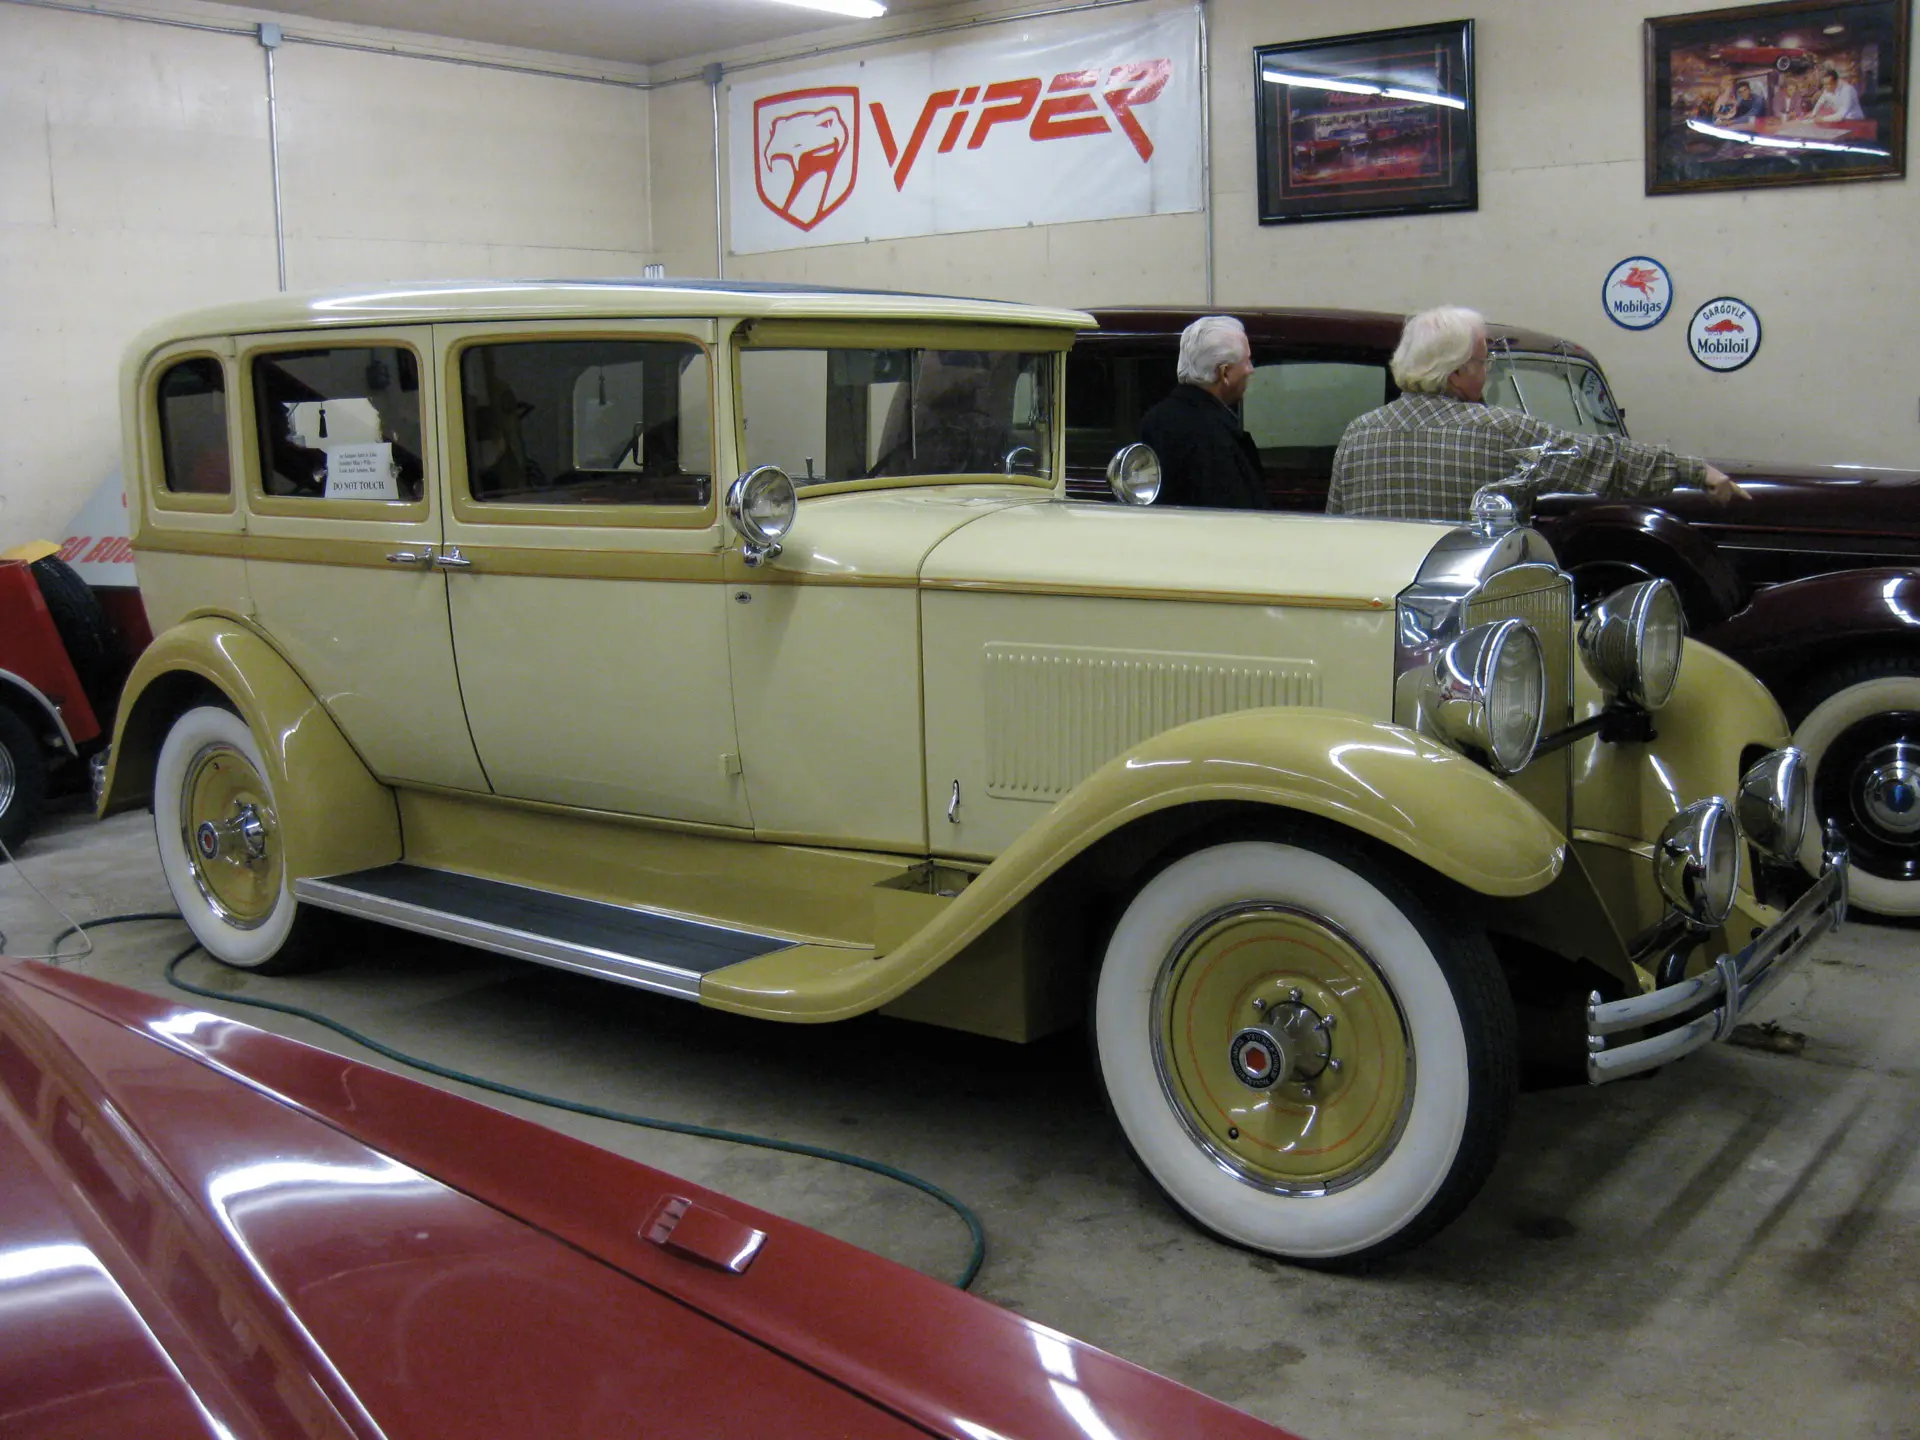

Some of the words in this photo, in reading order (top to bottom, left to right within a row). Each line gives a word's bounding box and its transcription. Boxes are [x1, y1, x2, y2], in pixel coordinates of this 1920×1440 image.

[1614, 300, 1662, 315] Mobilgas
[1703, 305, 1746, 321] GARGOYLE
[1697, 338, 1749, 354] Mobiloil
[333, 482, 343, 491] DO
[344, 481, 357, 490] NOT
[358, 481, 385, 490] TOUCH
